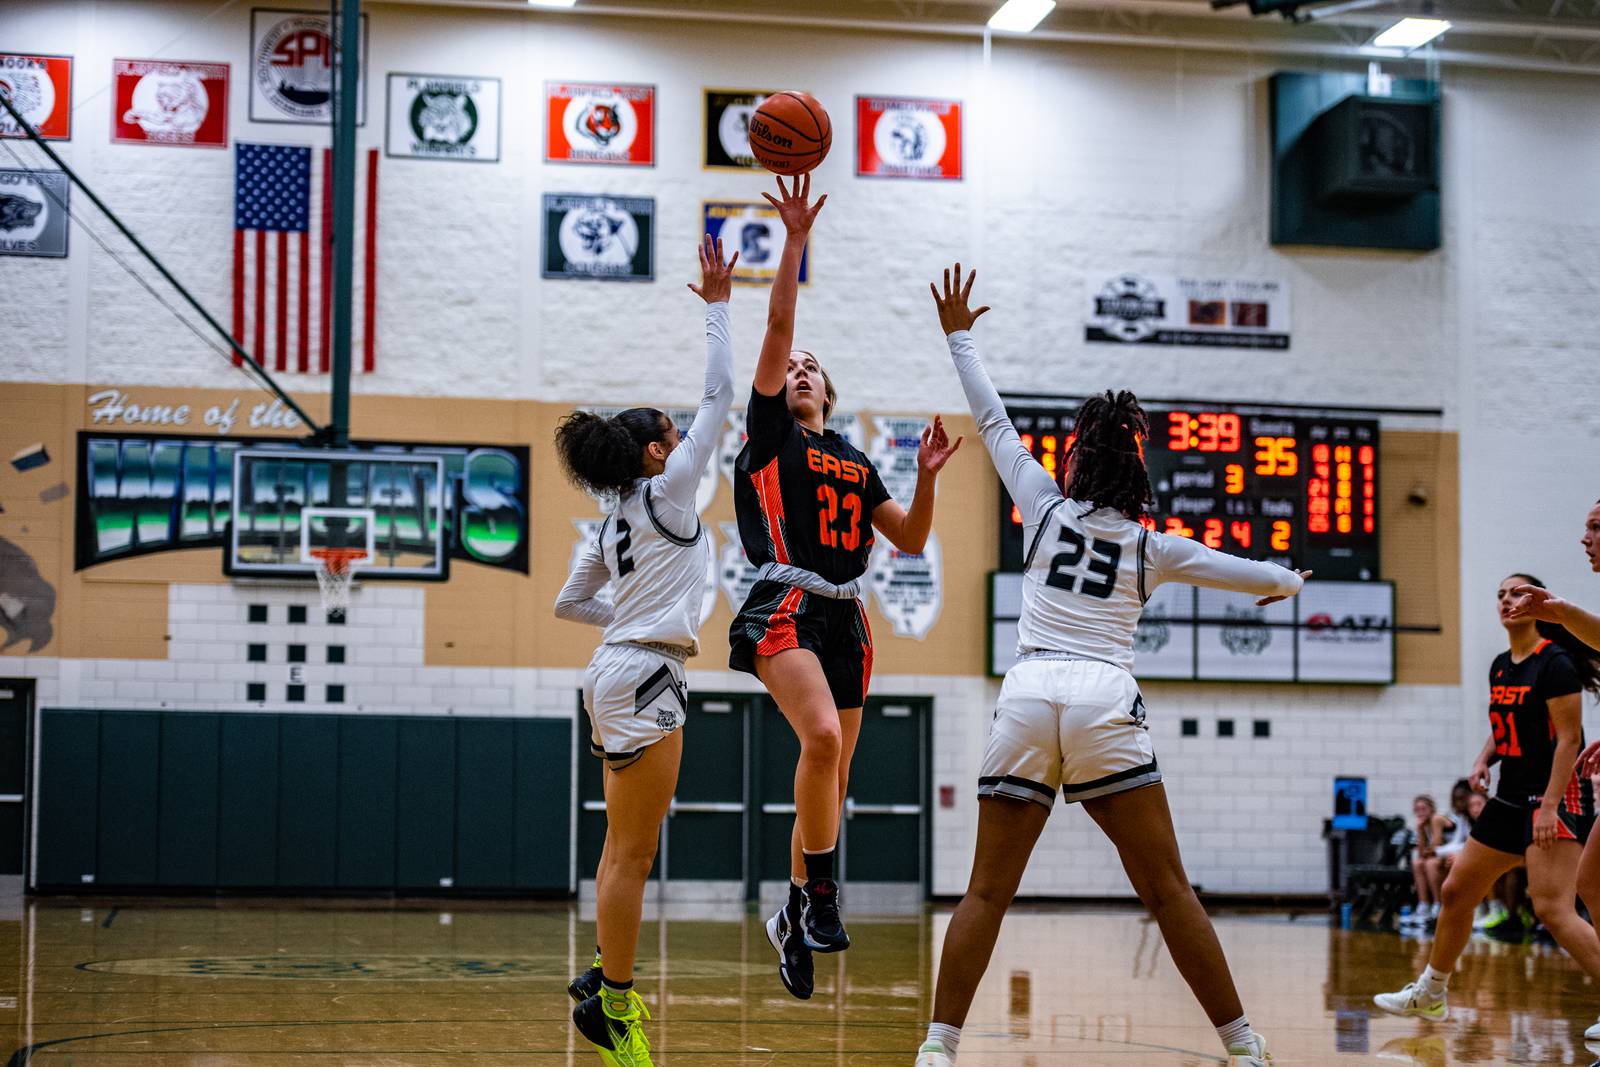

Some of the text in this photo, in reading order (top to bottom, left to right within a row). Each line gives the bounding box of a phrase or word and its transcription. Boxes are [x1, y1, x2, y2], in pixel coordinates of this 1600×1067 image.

[751, 117, 793, 149] Wilson
[88, 388, 300, 434] Home of the
[1168, 411, 1241, 452] 3:39
[807, 446, 869, 489] EAST
[1254, 436, 1298, 476] 35
[1224, 463, 1244, 495] 3
[816, 483, 862, 552] 23
[1270, 519, 1291, 551] 2
[616, 518, 636, 578] 2
[1045, 524, 1122, 600] 23
[1489, 711, 1522, 757] 21
